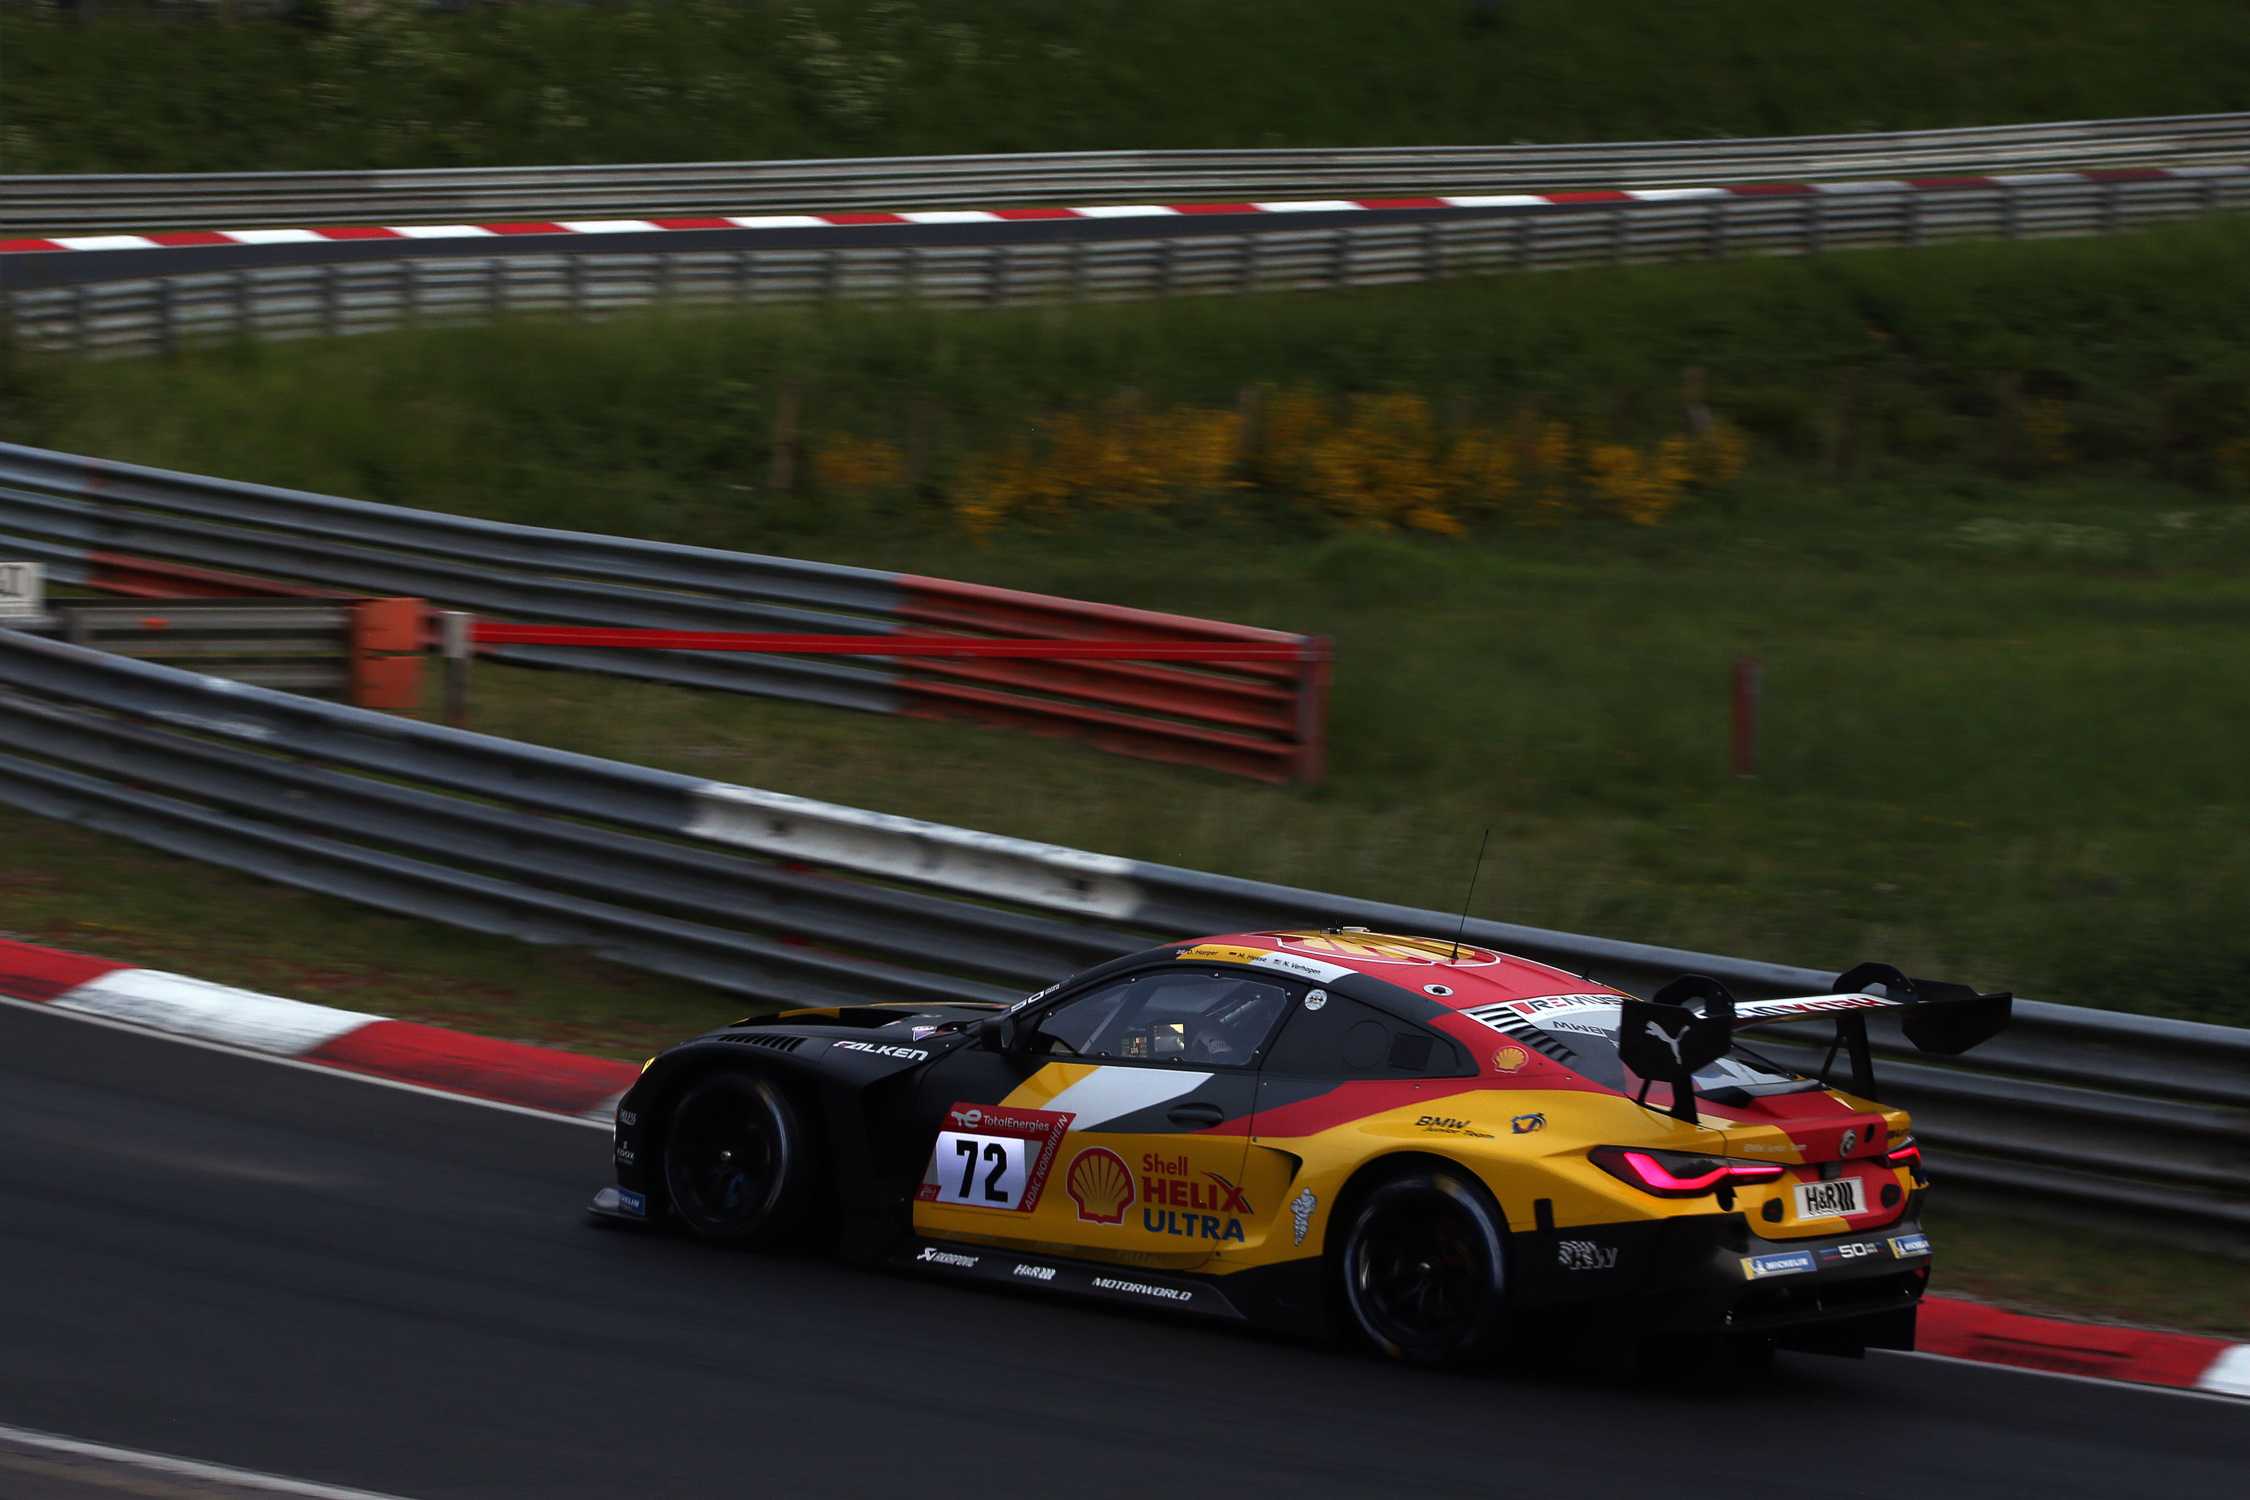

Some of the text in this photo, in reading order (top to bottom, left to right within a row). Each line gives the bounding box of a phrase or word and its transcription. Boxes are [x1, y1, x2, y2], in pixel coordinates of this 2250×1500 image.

[832, 1040, 929, 1062] FALKEN
[983, 1115, 1049, 1132] TotalEnergies
[1415, 1115, 1472, 1129] BMW
[956, 1139, 1008, 1202] 72
[1143, 1153, 1188, 1177] Shell
[1142, 1175, 1252, 1215] HELIX
[1143, 1208, 1245, 1243] ULTRA
[1092, 1276, 1193, 1302] MOTORWORLD
